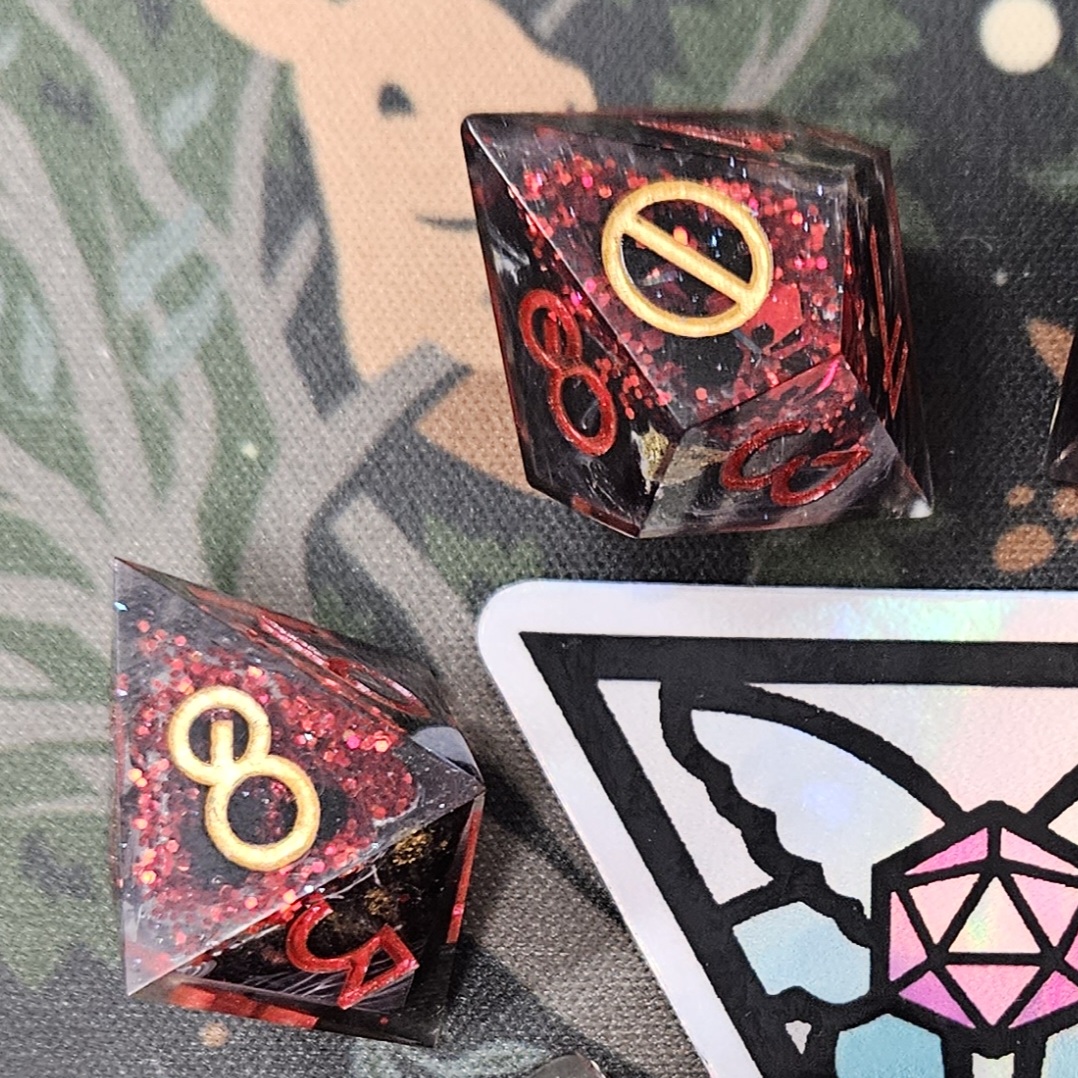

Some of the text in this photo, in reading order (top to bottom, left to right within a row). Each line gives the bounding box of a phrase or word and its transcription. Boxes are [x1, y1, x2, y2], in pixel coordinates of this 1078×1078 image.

[602, 181, 773, 338] 0
[519, 289, 617, 457] 8
[167, 685, 321, 871] 8
